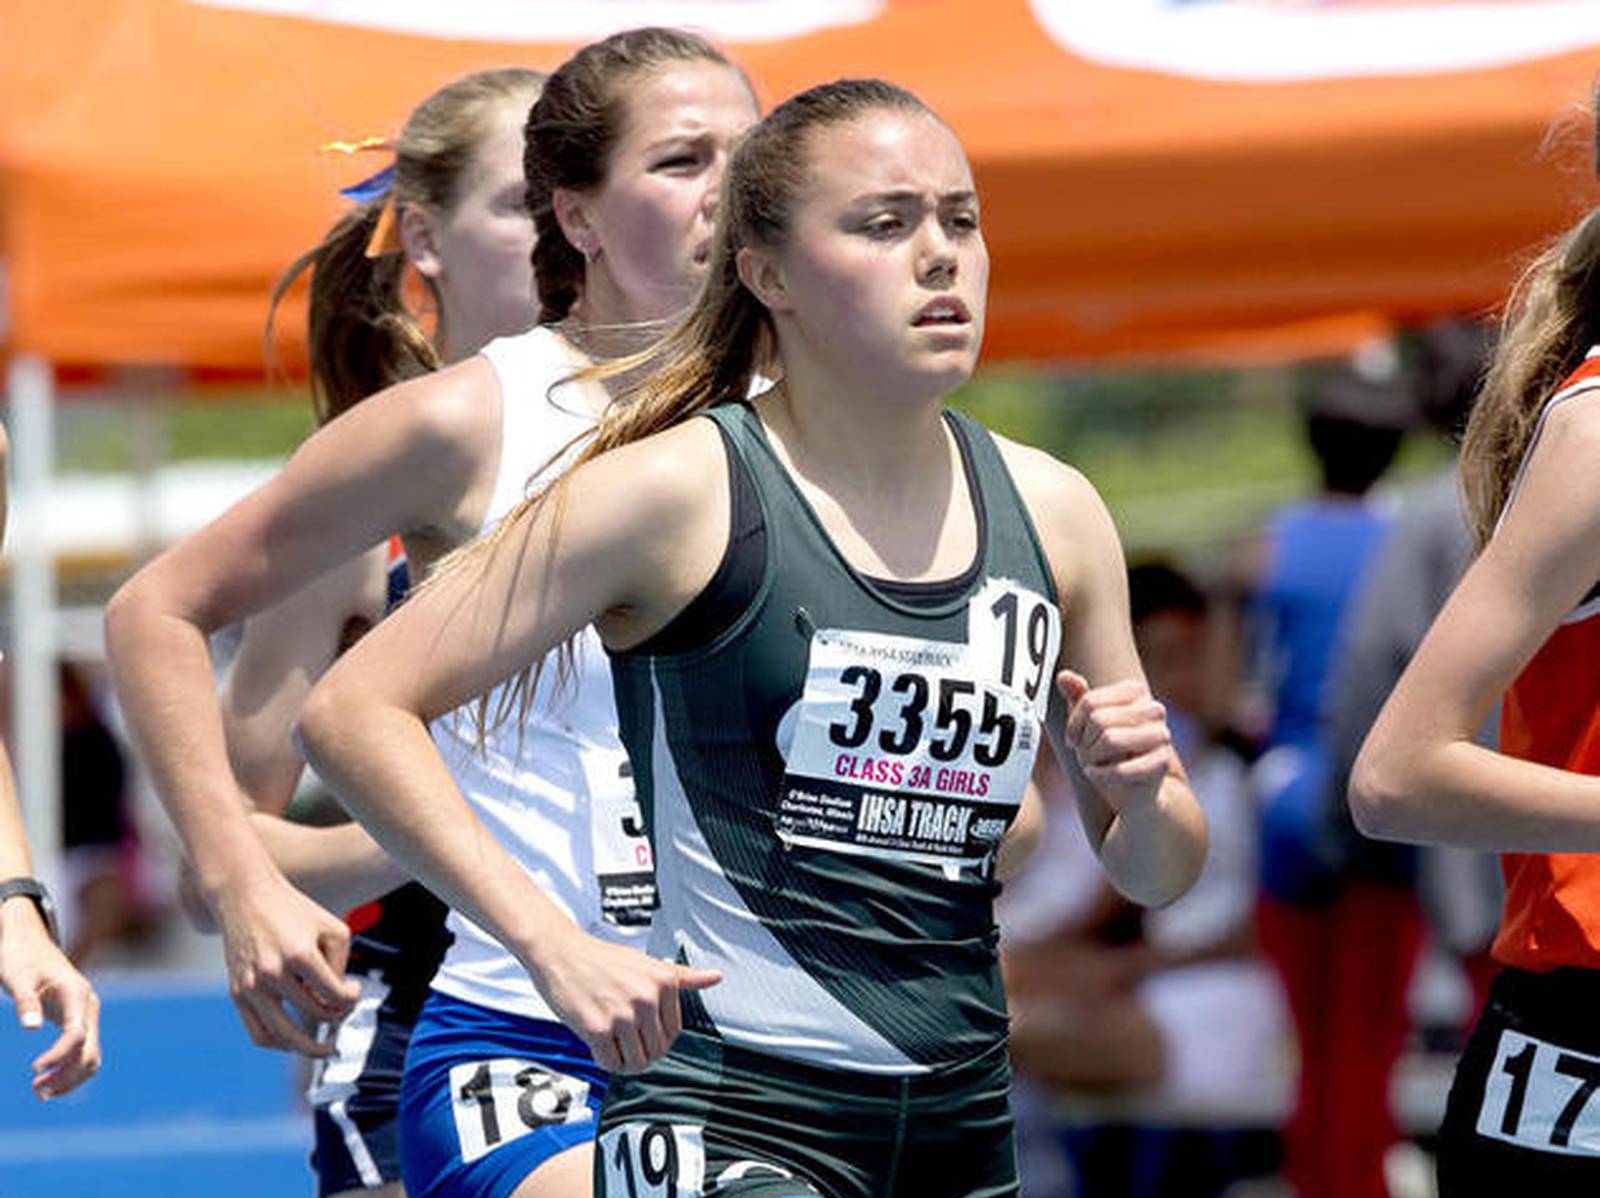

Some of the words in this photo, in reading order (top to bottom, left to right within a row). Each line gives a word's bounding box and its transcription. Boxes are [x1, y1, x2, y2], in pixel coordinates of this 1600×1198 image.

[989, 591, 1049, 701] 19
[829, 665, 1016, 767] 3355
[835, 753, 905, 786] CLASS
[908, 765, 932, 789] 3A
[936, 767, 990, 797] GIRLS
[857, 793, 907, 836] IHSA
[907, 800, 974, 843] TRACK
[1503, 1041, 1600, 1148] 17
